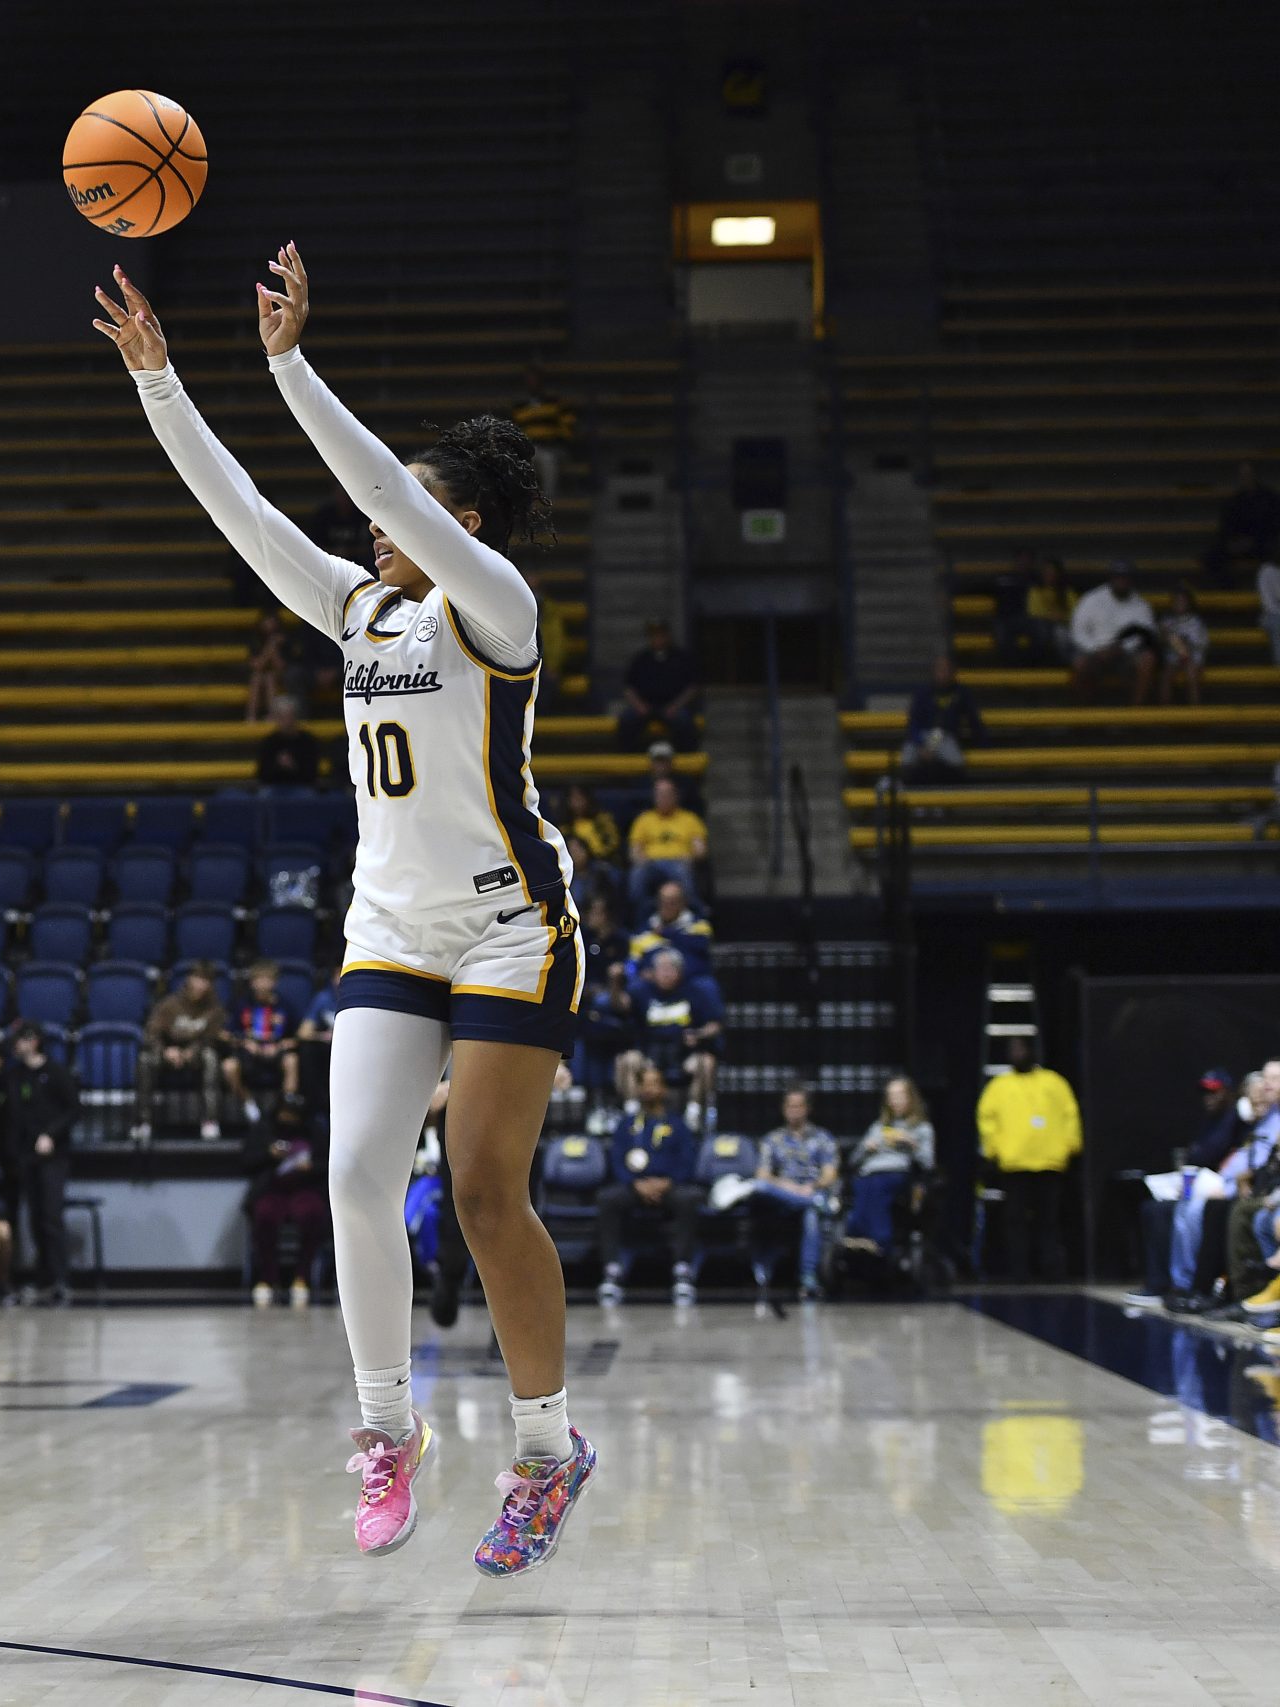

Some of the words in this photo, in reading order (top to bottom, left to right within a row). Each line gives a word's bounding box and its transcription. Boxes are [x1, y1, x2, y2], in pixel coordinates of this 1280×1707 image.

[67, 182, 116, 206] lson
[359, 721, 417, 799] 10
[503, 871, 513, 881] M
